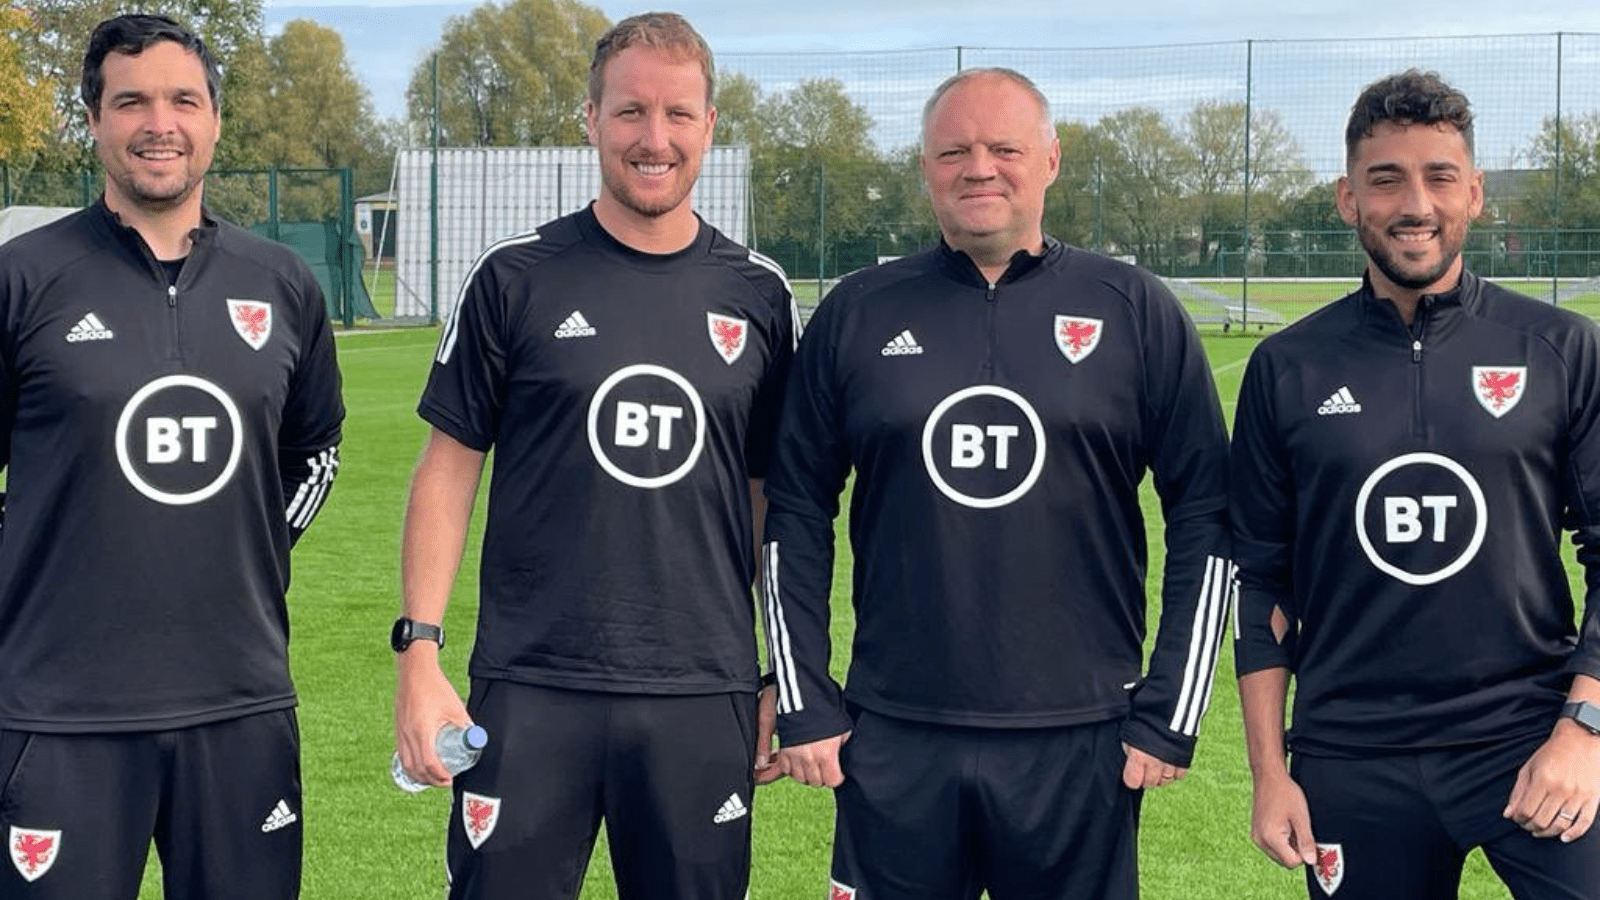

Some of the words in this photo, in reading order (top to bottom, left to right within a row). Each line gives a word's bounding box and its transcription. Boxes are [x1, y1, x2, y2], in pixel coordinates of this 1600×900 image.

[65, 329, 114, 343] adidas
[554, 325, 597, 339] adidas
[880, 345, 924, 357] adidas
[1317, 401, 1362, 415] adidas
[615, 401, 683, 450] BT
[146, 416, 217, 464] BT
[951, 424, 1019, 470] BT
[1385, 495, 1458, 543] BT
[261, 814, 297, 833] adidas
[713, 806, 748, 824] adidas
